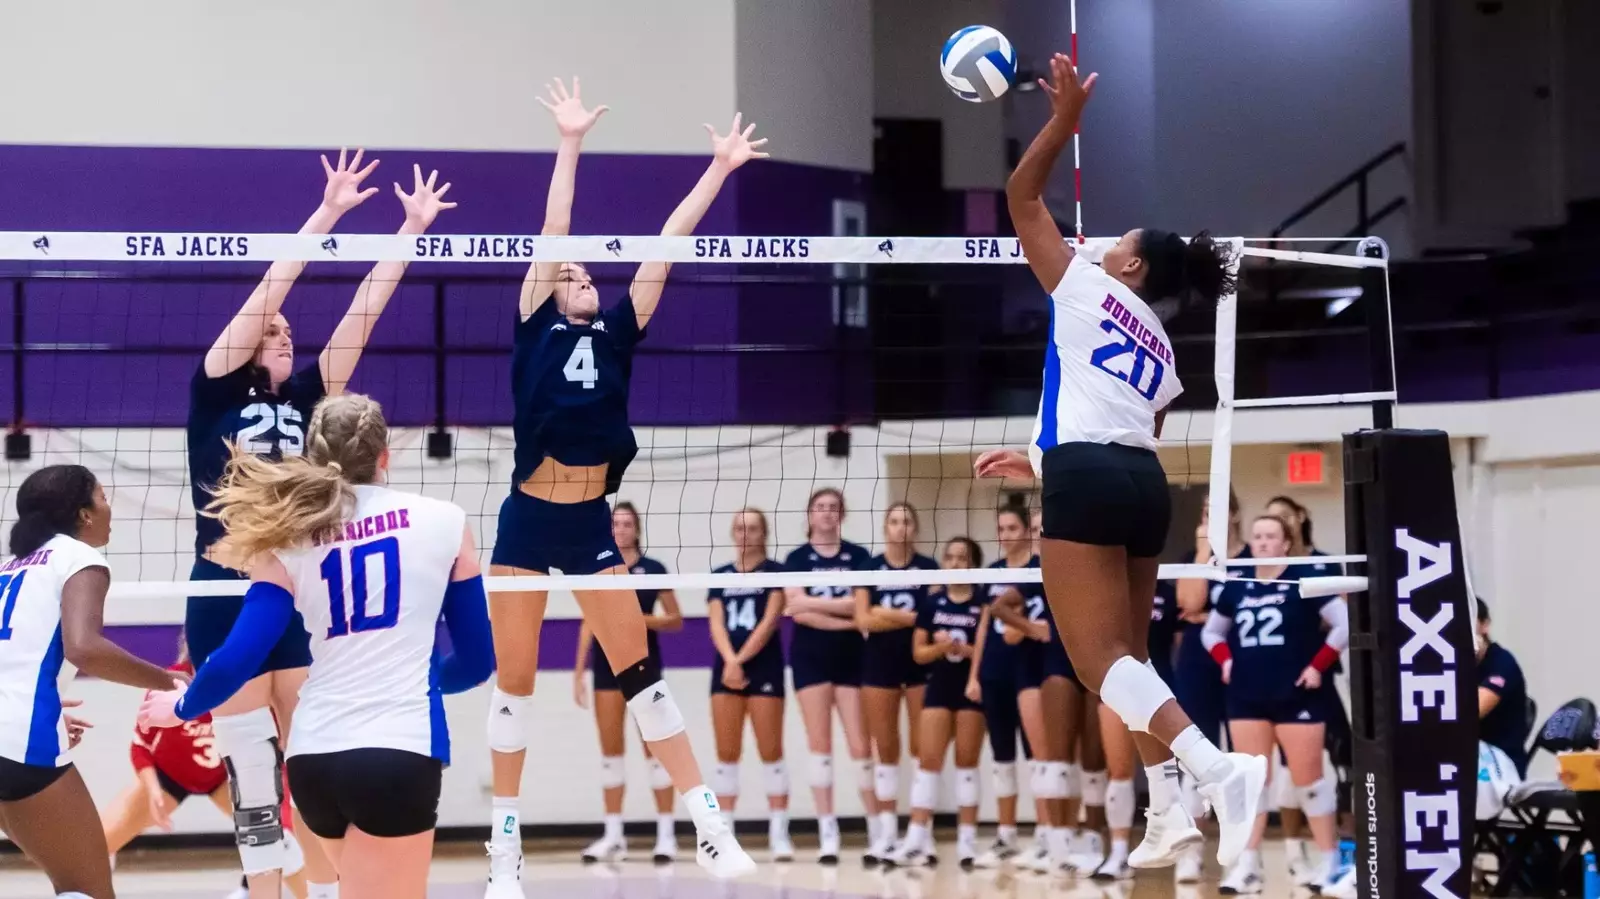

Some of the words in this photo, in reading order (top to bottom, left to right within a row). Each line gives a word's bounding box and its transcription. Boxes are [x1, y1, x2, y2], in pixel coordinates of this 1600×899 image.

[126, 236, 165, 256] SFA
[176, 236, 249, 257] JACKS
[415, 237, 453, 257] SFA
[463, 237, 535, 257] JACKS
[695, 238, 732, 258] SFA
[742, 238, 810, 258] JACKS
[965, 239, 1001, 258] SFA
[562, 336, 599, 389] 4
[1090, 319, 1164, 401] 20
[236, 402, 304, 457] 25
[320, 536, 401, 640] 10
[726, 598, 757, 631] 14
[1235, 606, 1285, 648] 22
[1395, 528, 1457, 722] AXE
[1365, 772, 1378, 833] sports
